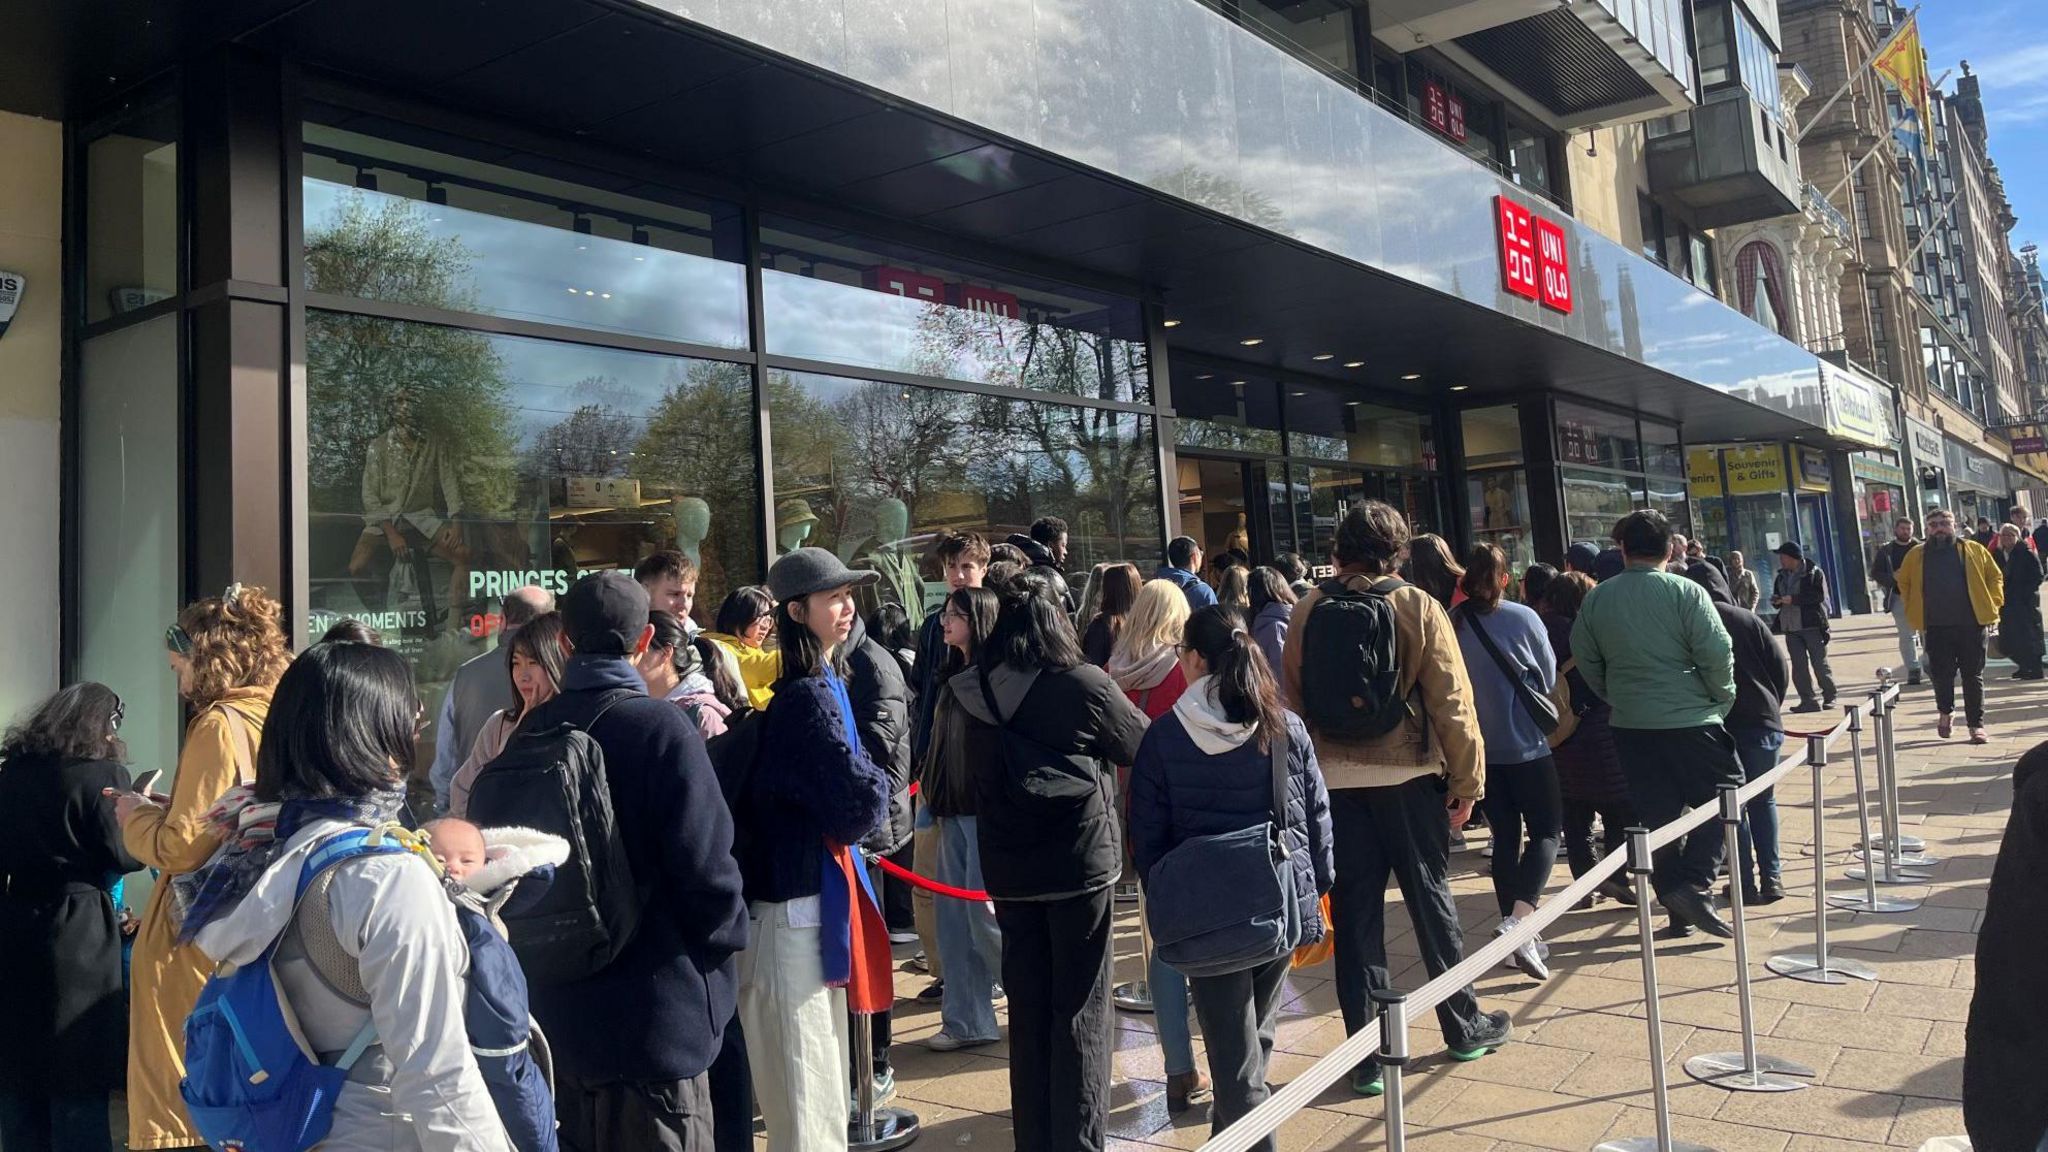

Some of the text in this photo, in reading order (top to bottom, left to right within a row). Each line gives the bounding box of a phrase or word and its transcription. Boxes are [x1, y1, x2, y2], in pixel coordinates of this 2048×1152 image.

[1541, 228, 1563, 265] UNI
[1545, 265, 1568, 301] QLO
[1737, 470, 1776, 481] & Gifts
[470, 570, 569, 598] PRINCES
